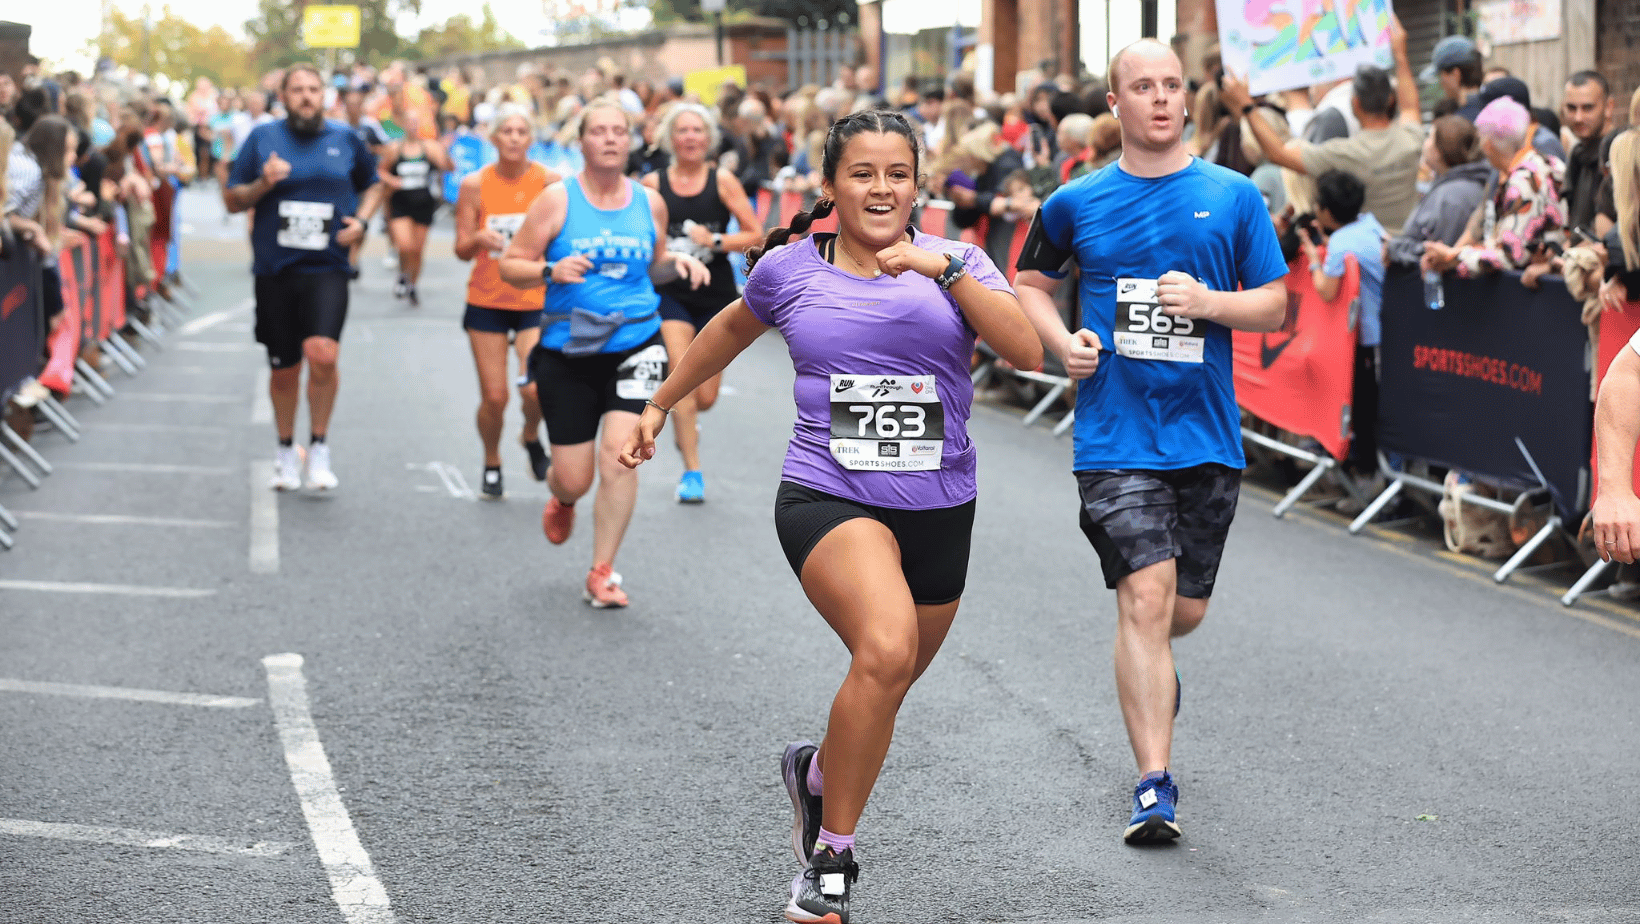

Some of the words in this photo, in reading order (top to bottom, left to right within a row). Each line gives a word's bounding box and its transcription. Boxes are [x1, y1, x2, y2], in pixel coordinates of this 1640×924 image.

[1128, 303, 1194, 335] 565
[1413, 345, 1542, 395] SPORTSSHOES.COM
[839, 379, 855, 387] RUN
[849, 405, 926, 438] 763
[836, 446, 860, 454] TREK
[849, 460, 924, 468] SPORTSSHOES.COM
